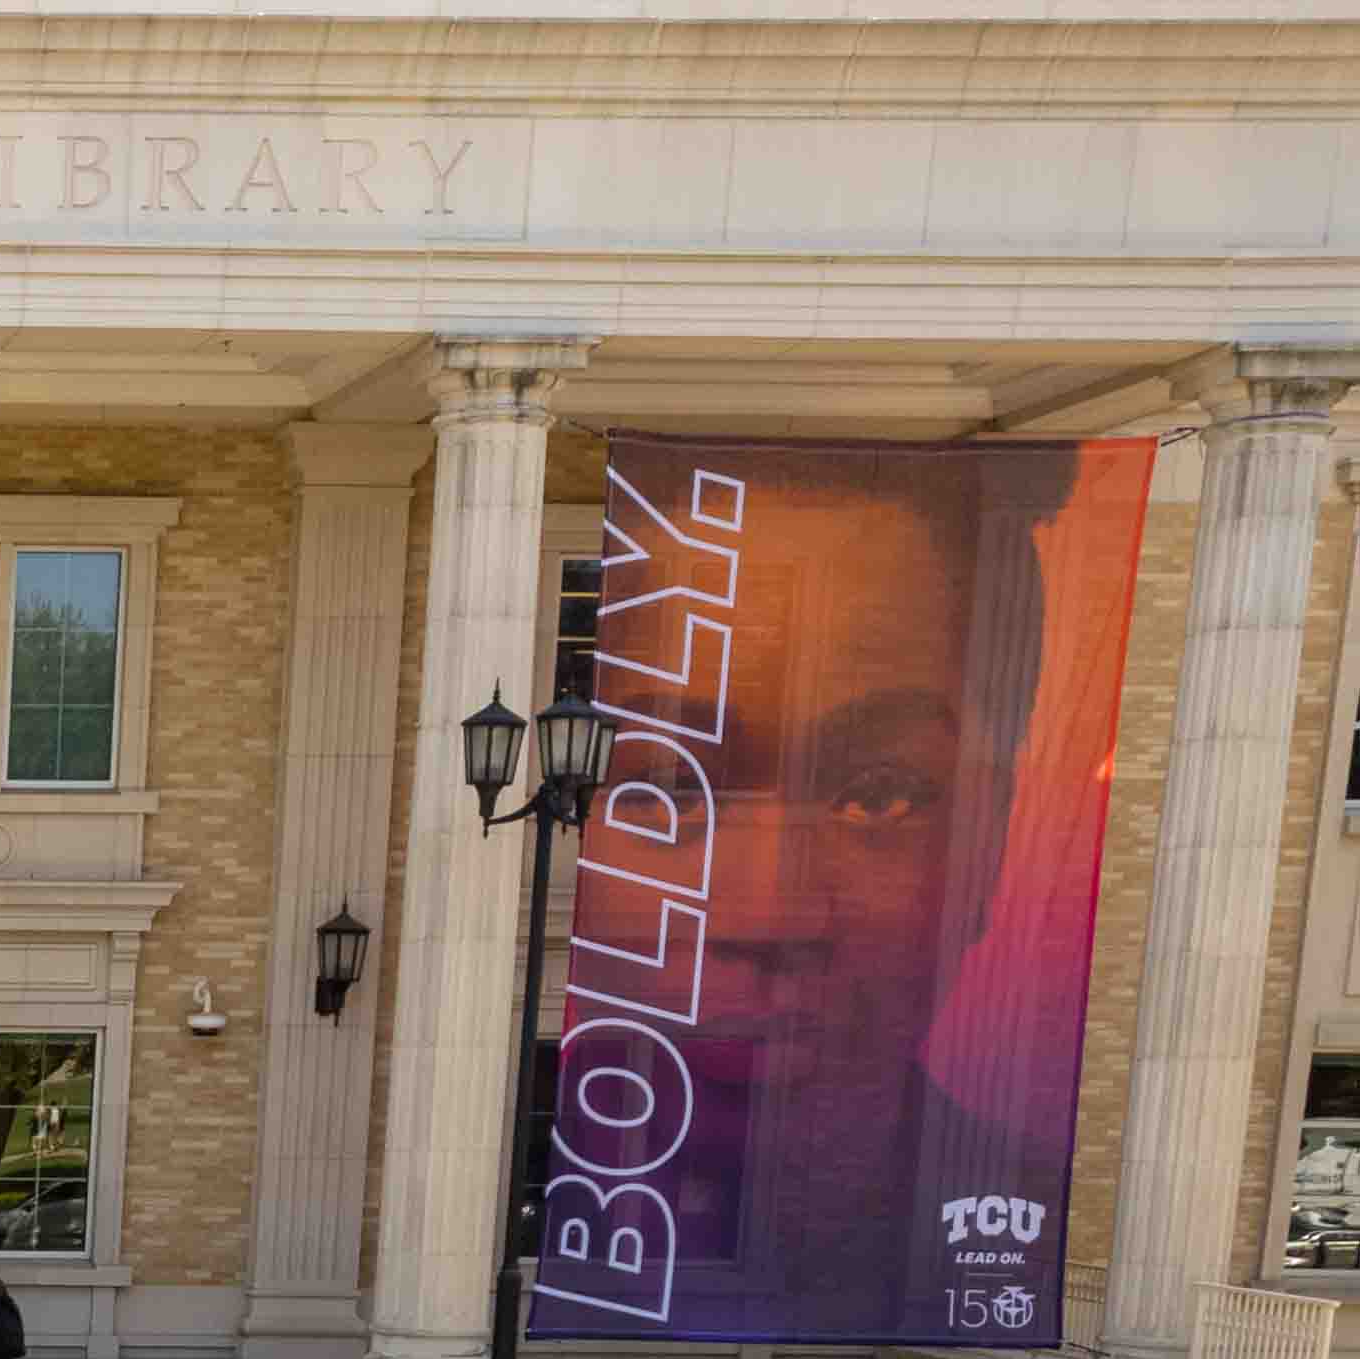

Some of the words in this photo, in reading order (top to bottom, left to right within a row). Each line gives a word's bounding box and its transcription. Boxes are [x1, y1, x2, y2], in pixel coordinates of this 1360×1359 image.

[533, 464, 746, 1323] BOLDLY.
[942, 1195, 1046, 1243] TCU
[955, 1251, 997, 1264] LEAD
[1000, 1252, 1026, 1264] ON.
